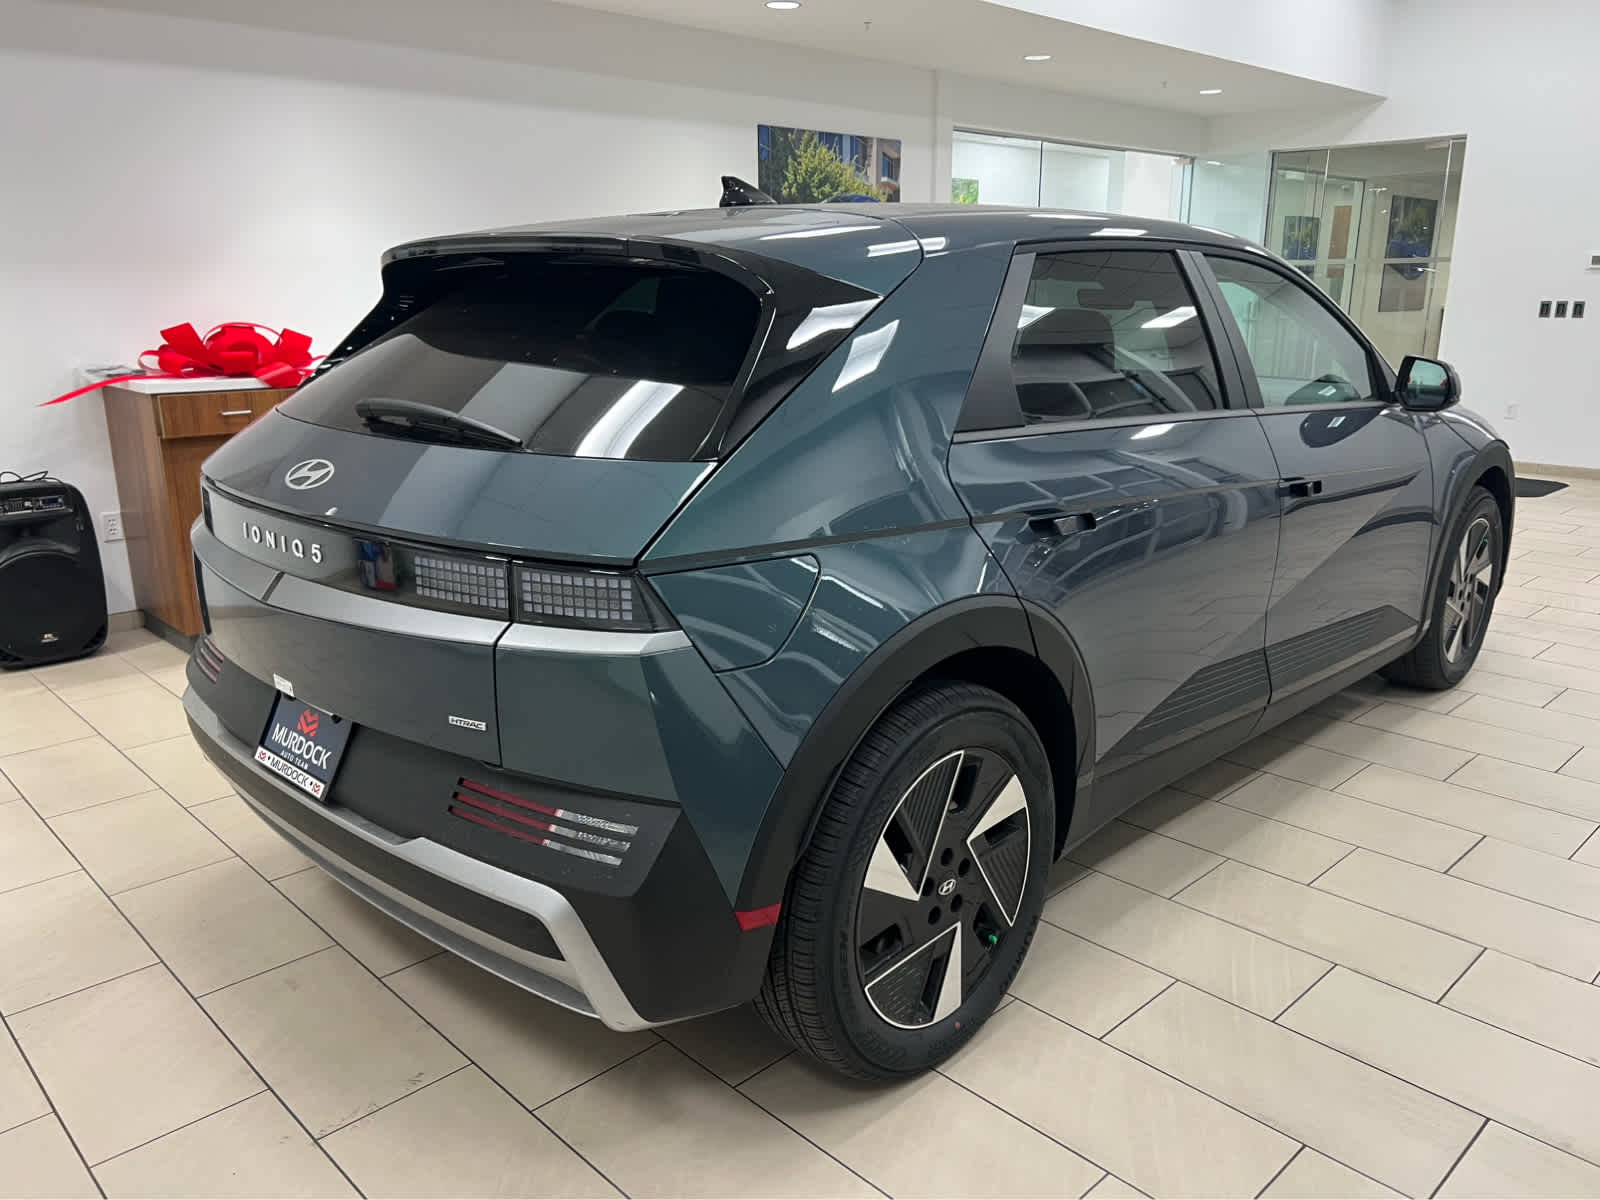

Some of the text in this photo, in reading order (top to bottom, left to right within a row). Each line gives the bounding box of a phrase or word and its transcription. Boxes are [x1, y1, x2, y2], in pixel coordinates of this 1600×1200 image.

[243, 521, 322, 563] IONIQ 5
[451, 717, 484, 730] HTRAC
[271, 723, 332, 769] MURDOCK
[281, 749, 309, 770] AUTO TEAM
[270, 757, 310, 787] MURDOCK
